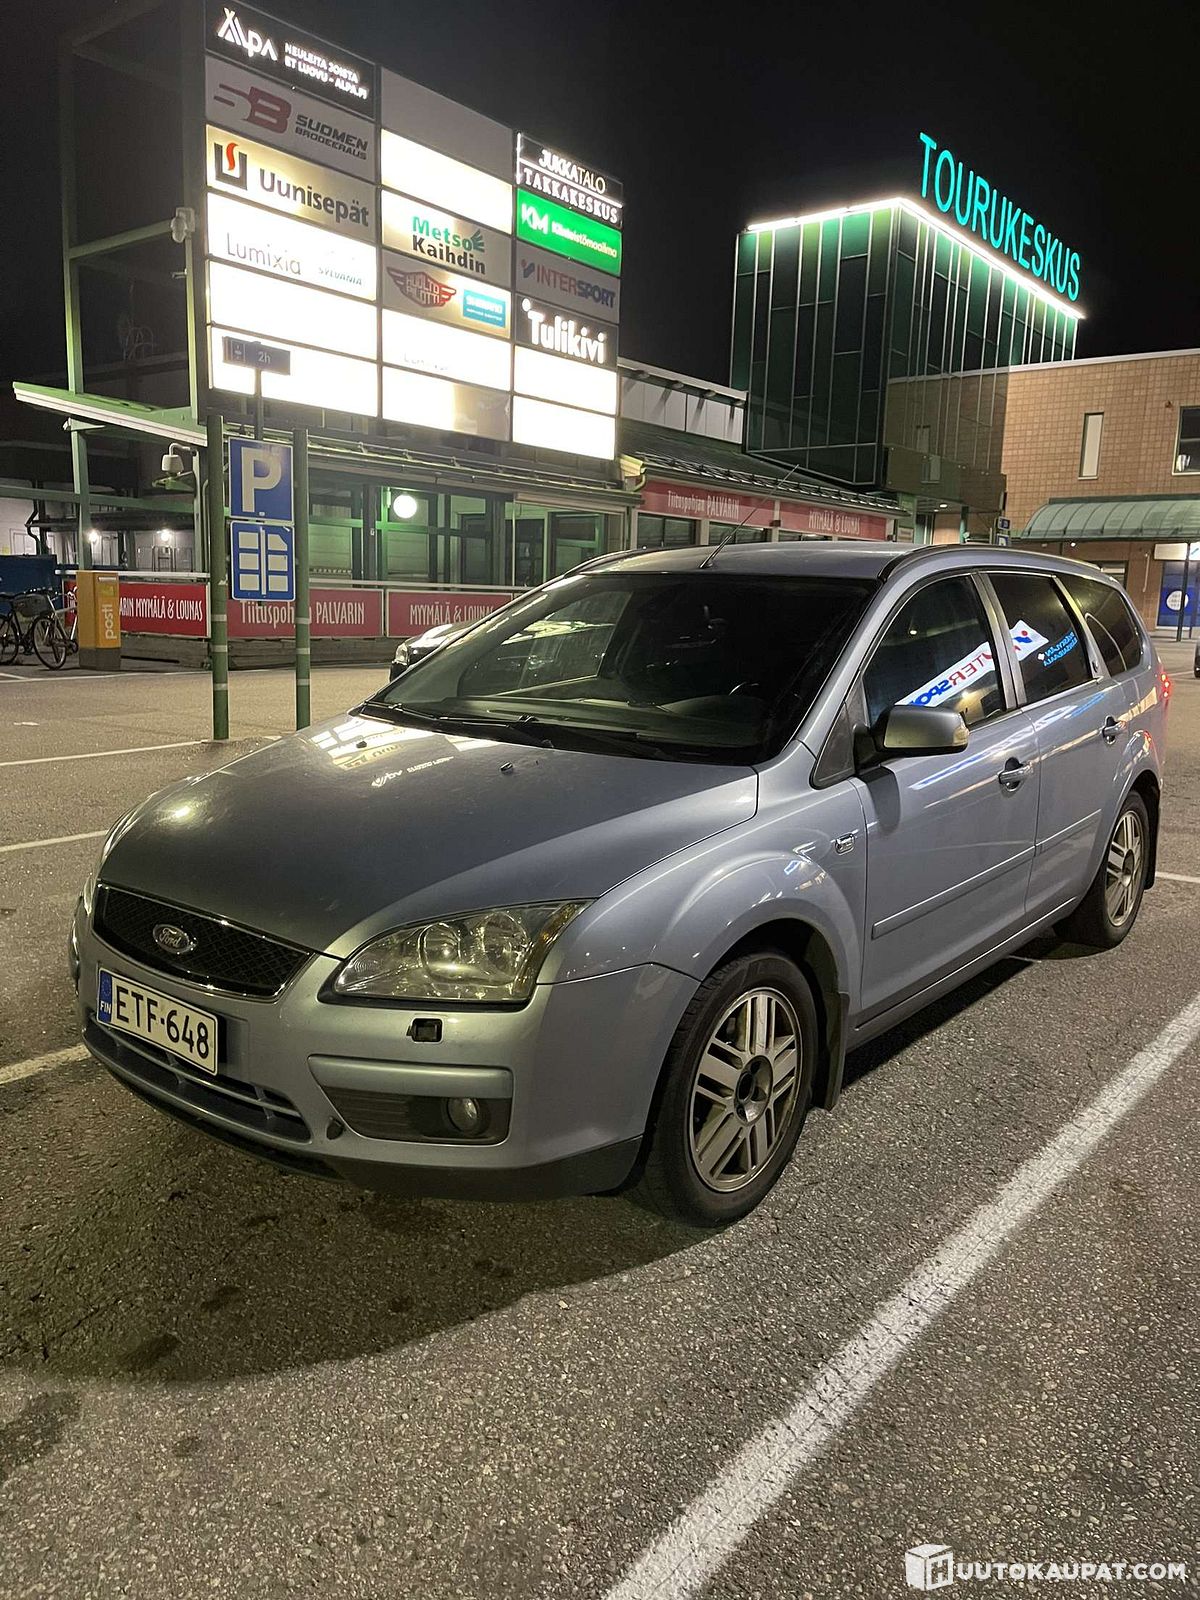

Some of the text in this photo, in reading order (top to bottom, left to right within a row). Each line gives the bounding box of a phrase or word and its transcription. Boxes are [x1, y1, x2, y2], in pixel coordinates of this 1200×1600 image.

[298, 61, 328, 83] LUOVU
[295, 126, 367, 160] BRODEERAUS
[296, 113, 368, 151] SUOMEN
[539, 148, 606, 194] JUKKATALO
[260, 168, 369, 227] Uunisepät
[523, 167, 618, 224] TAKKAKESKUS
[412, 216, 474, 251] Metso
[521, 202, 549, 235] KM
[919, 132, 1080, 301] TOURUKESKUS
[227, 232, 301, 275] Lumixia
[412, 234, 486, 275] Kaihdin
[537, 264, 616, 308] INTERSPORT
[525, 304, 605, 364] Tulikivi
[258, 351, 271, 364] 2h
[241, 446, 282, 513] P
[706, 494, 740, 519] PALVARIN
[101, 603, 118, 641] posti
[136, 595, 166, 618] MYYMÄLÄ
[167, 599, 174, 619] &
[176, 600, 203, 622] LOUNAS
[241, 600, 365, 630] Tiituspoh PALVARIN
[409, 601, 451, 625] MYYMÄLÄ
[100, 1000, 112, 1015] FIN
[116, 985, 210, 1059] ETF-648
